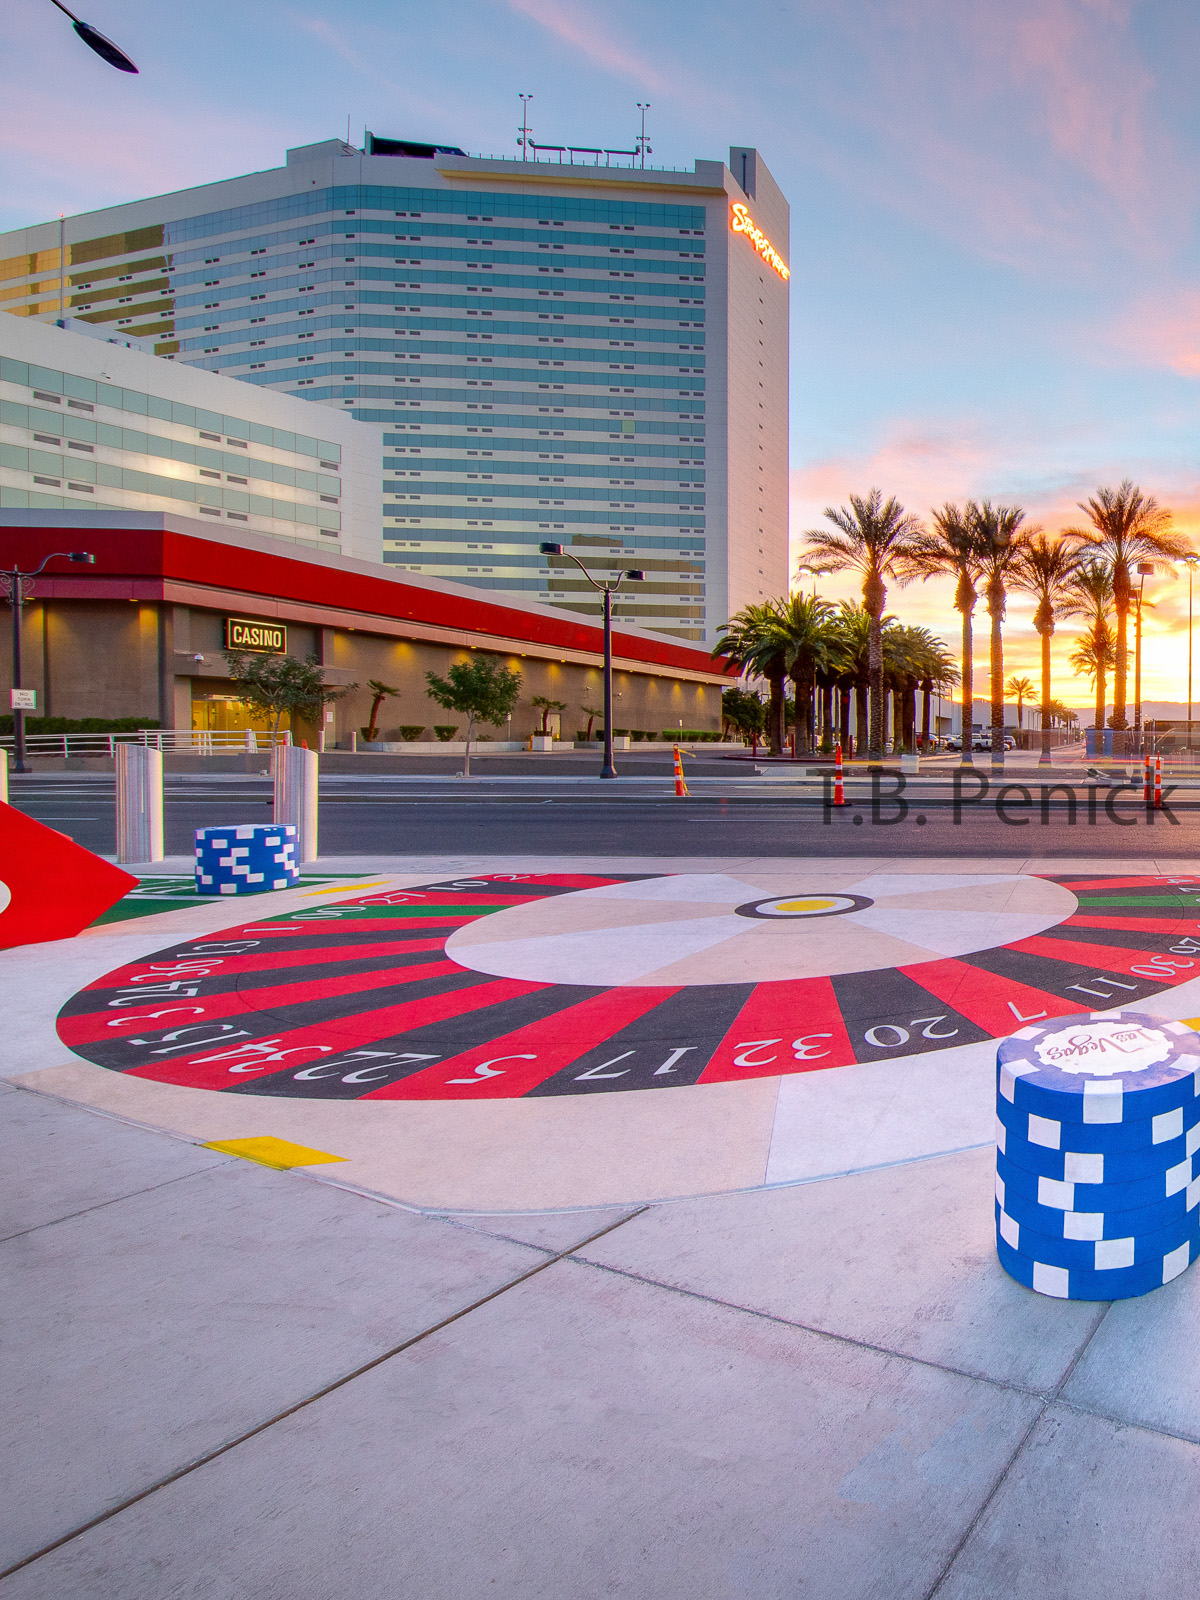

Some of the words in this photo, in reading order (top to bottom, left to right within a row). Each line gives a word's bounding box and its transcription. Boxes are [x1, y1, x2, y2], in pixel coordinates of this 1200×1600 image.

[232, 625, 282, 648] CASINO
[427, 880, 489, 892] 10
[358, 891, 426, 905] 27
[291, 906, 367, 920] 00
[243, 926, 303, 934] 1
[177, 940, 261, 958] 13
[130, 959, 224, 982] 36
[1130, 955, 1195, 978] 30
[107, 979, 203, 1006] 24
[1065, 976, 1139, 999] 11
[106, 1006, 205, 1027] 3
[1007, 1001, 1048, 1022] 7
[126, 1024, 253, 1054] 15
[864, 1015, 959, 1048] 20
[187, 1039, 333, 1074] 34
[733, 1033, 834, 1067] 32
[1046, 1034, 1144, 1060] Vegas
[293, 1051, 442, 1084] 22
[444, 1054, 538, 1085] 5
[573, 1046, 699, 1081] 17
